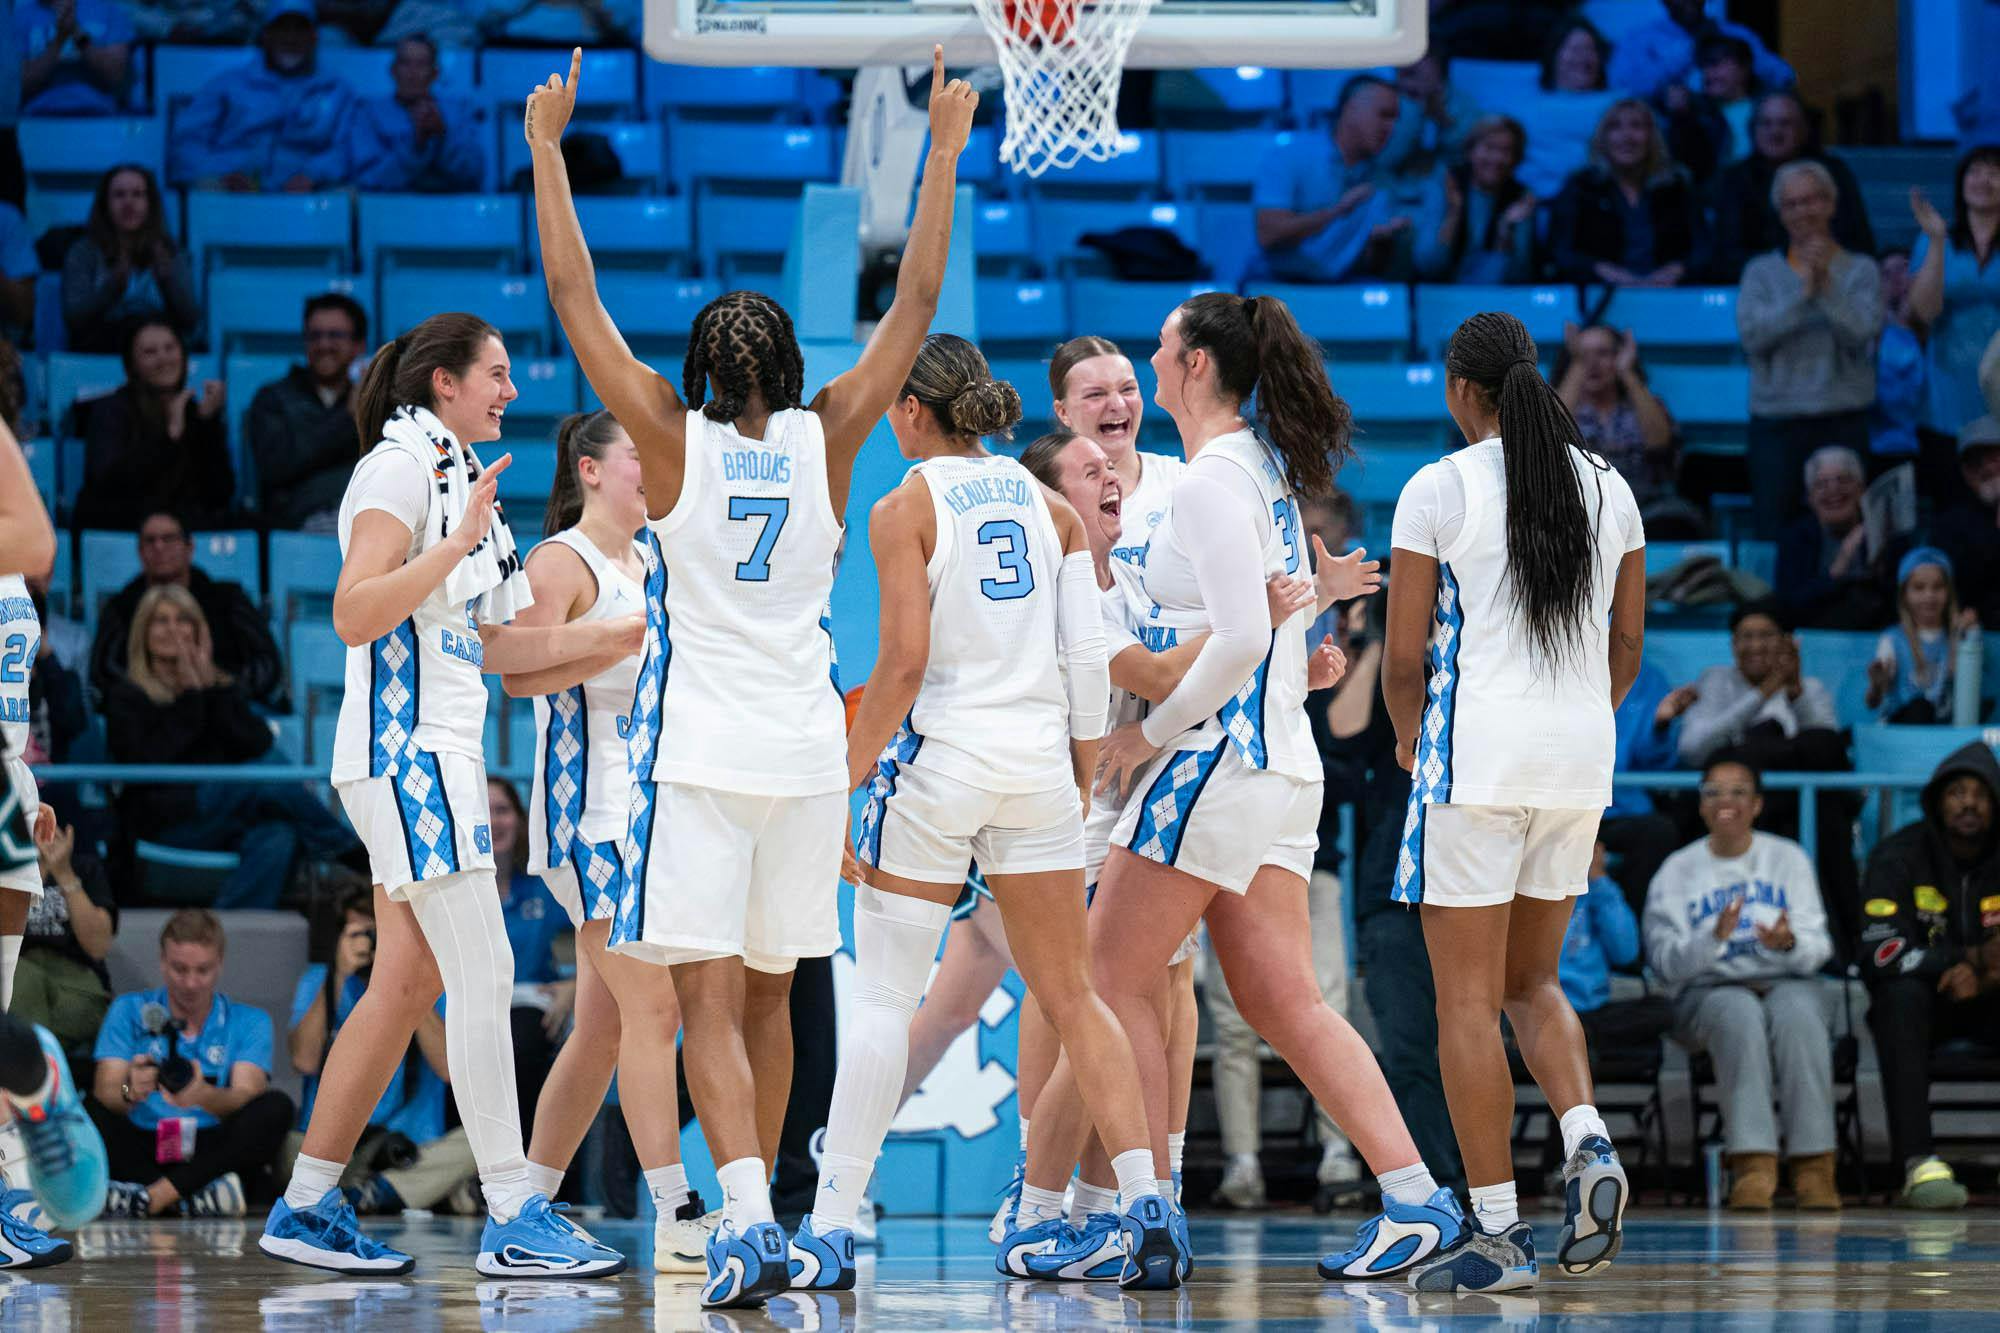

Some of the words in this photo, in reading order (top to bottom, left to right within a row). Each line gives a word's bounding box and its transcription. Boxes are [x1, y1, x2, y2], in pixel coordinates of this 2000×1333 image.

[722, 450, 791, 484] BROOKS
[728, 496, 789, 581] 7
[977, 519, 1035, 601] 3
